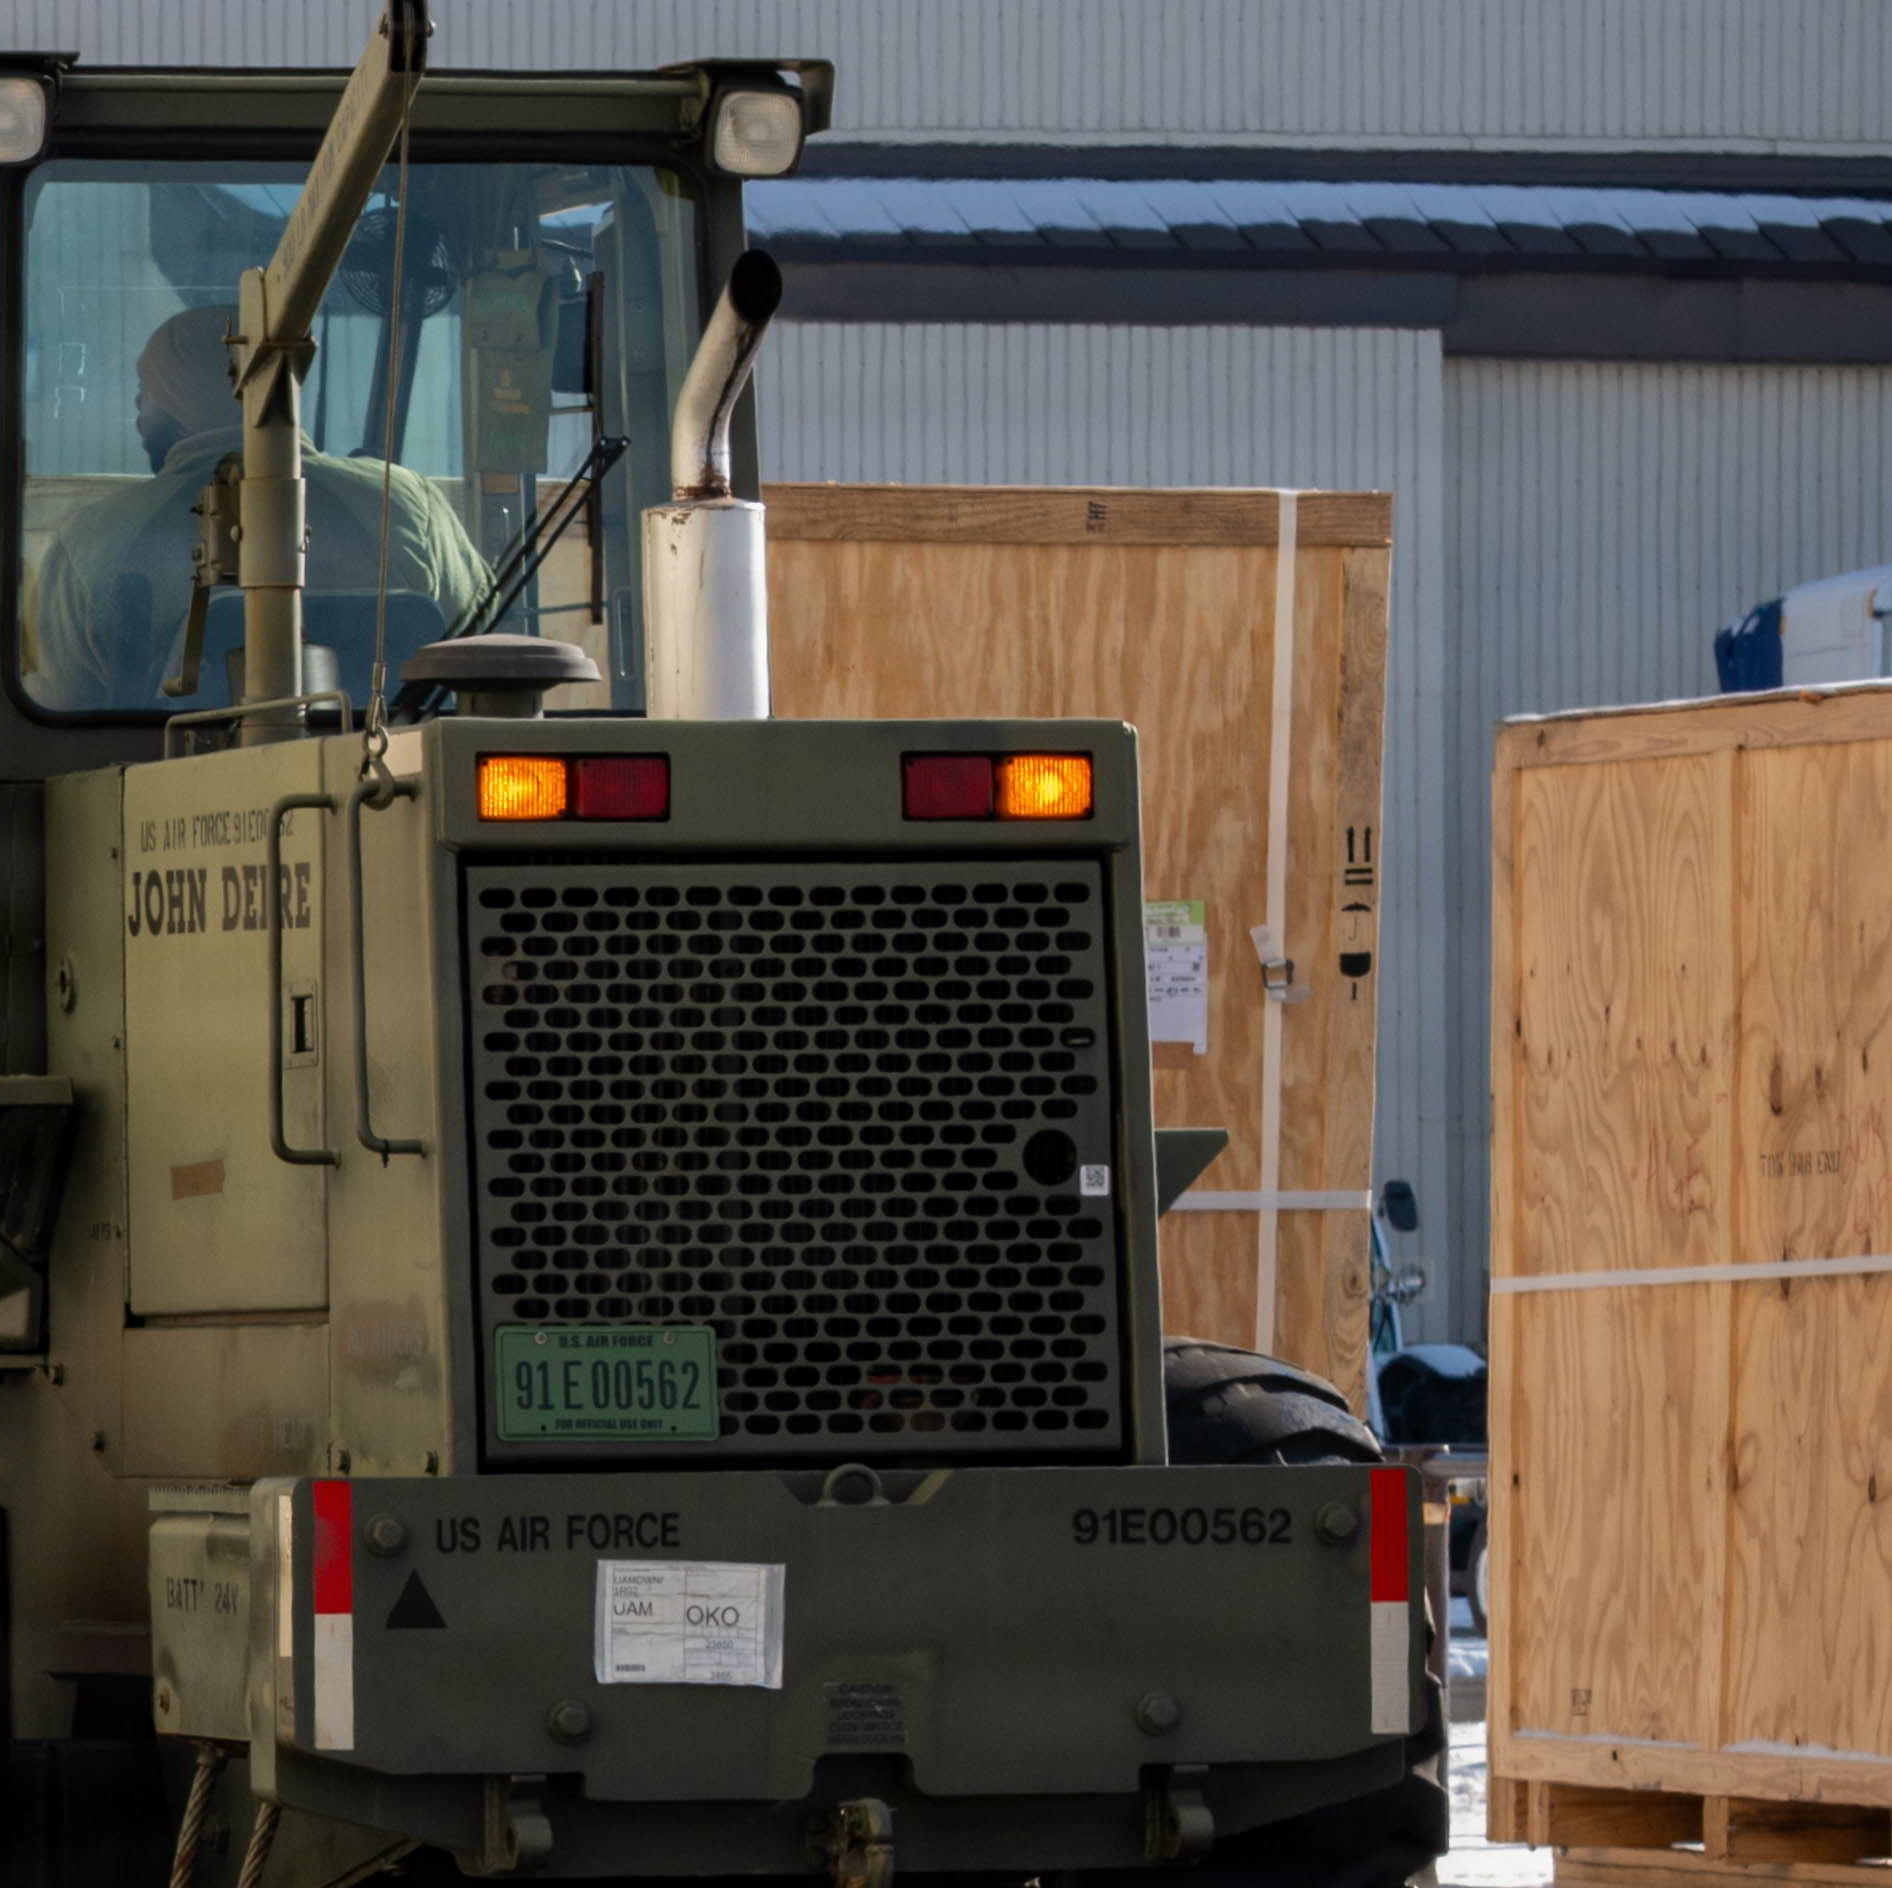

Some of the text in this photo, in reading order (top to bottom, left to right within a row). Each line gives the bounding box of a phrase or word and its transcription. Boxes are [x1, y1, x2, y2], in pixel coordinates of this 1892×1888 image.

[140, 820, 157, 852] US
[163, 816, 186, 852] AIR
[192, 811, 231, 849] FORCE
[127, 868, 207, 937] JOHN
[436, 1512, 680, 1554] US AIR FORCE
[1072, 1507, 1293, 1545] 91E00562
[686, 1604, 740, 1627] OKO
